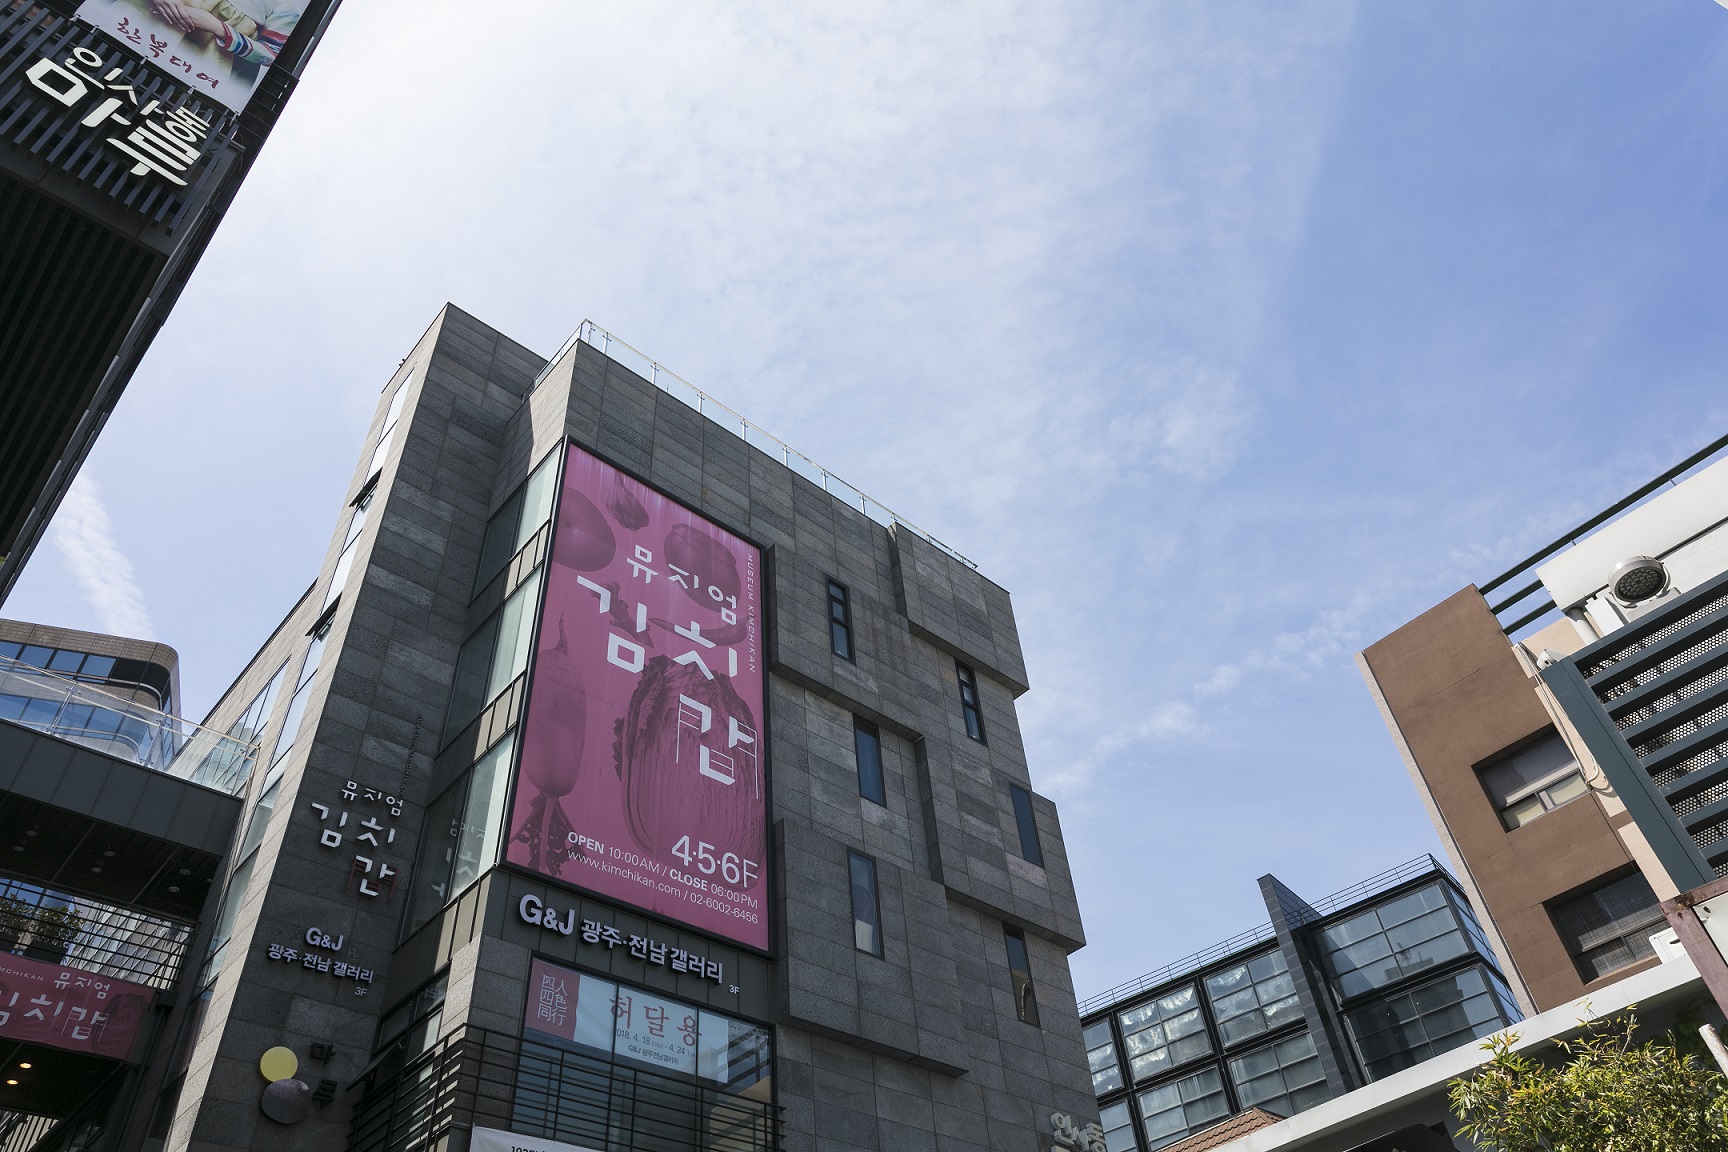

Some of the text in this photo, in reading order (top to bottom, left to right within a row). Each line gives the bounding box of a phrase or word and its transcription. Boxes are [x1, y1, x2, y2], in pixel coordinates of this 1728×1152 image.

[25, 57, 201, 186] 마루
[626, 544, 737, 626] 뮤지엄
[746, 553, 756, 673] MUSEUM KIMCHIKAN
[341, 780, 404, 817] 뮤지엄
[567, 831, 605, 855] OPEN
[669, 868, 709, 892] CLOSE
[567, 849, 681, 899] www.kimchikan.com
[689, 891, 759, 925] 02-6002-6456
[305, 926, 344, 952] G&J
[519, 893, 576, 937] G&J
[670, 946, 723, 985] 갤러리
[54, 972, 111, 1000] 뮤지엄
[333, 959, 374, 984] 갤러리
[354, 987, 368, 998] 3F
[728, 984, 740, 996] 3F
[615, 1028, 631, 1040] 018.
[642, 1036, 651, 1045] 18
[676, 1046, 685, 1055] 24
[628, 1044, 642, 1054] G&J
